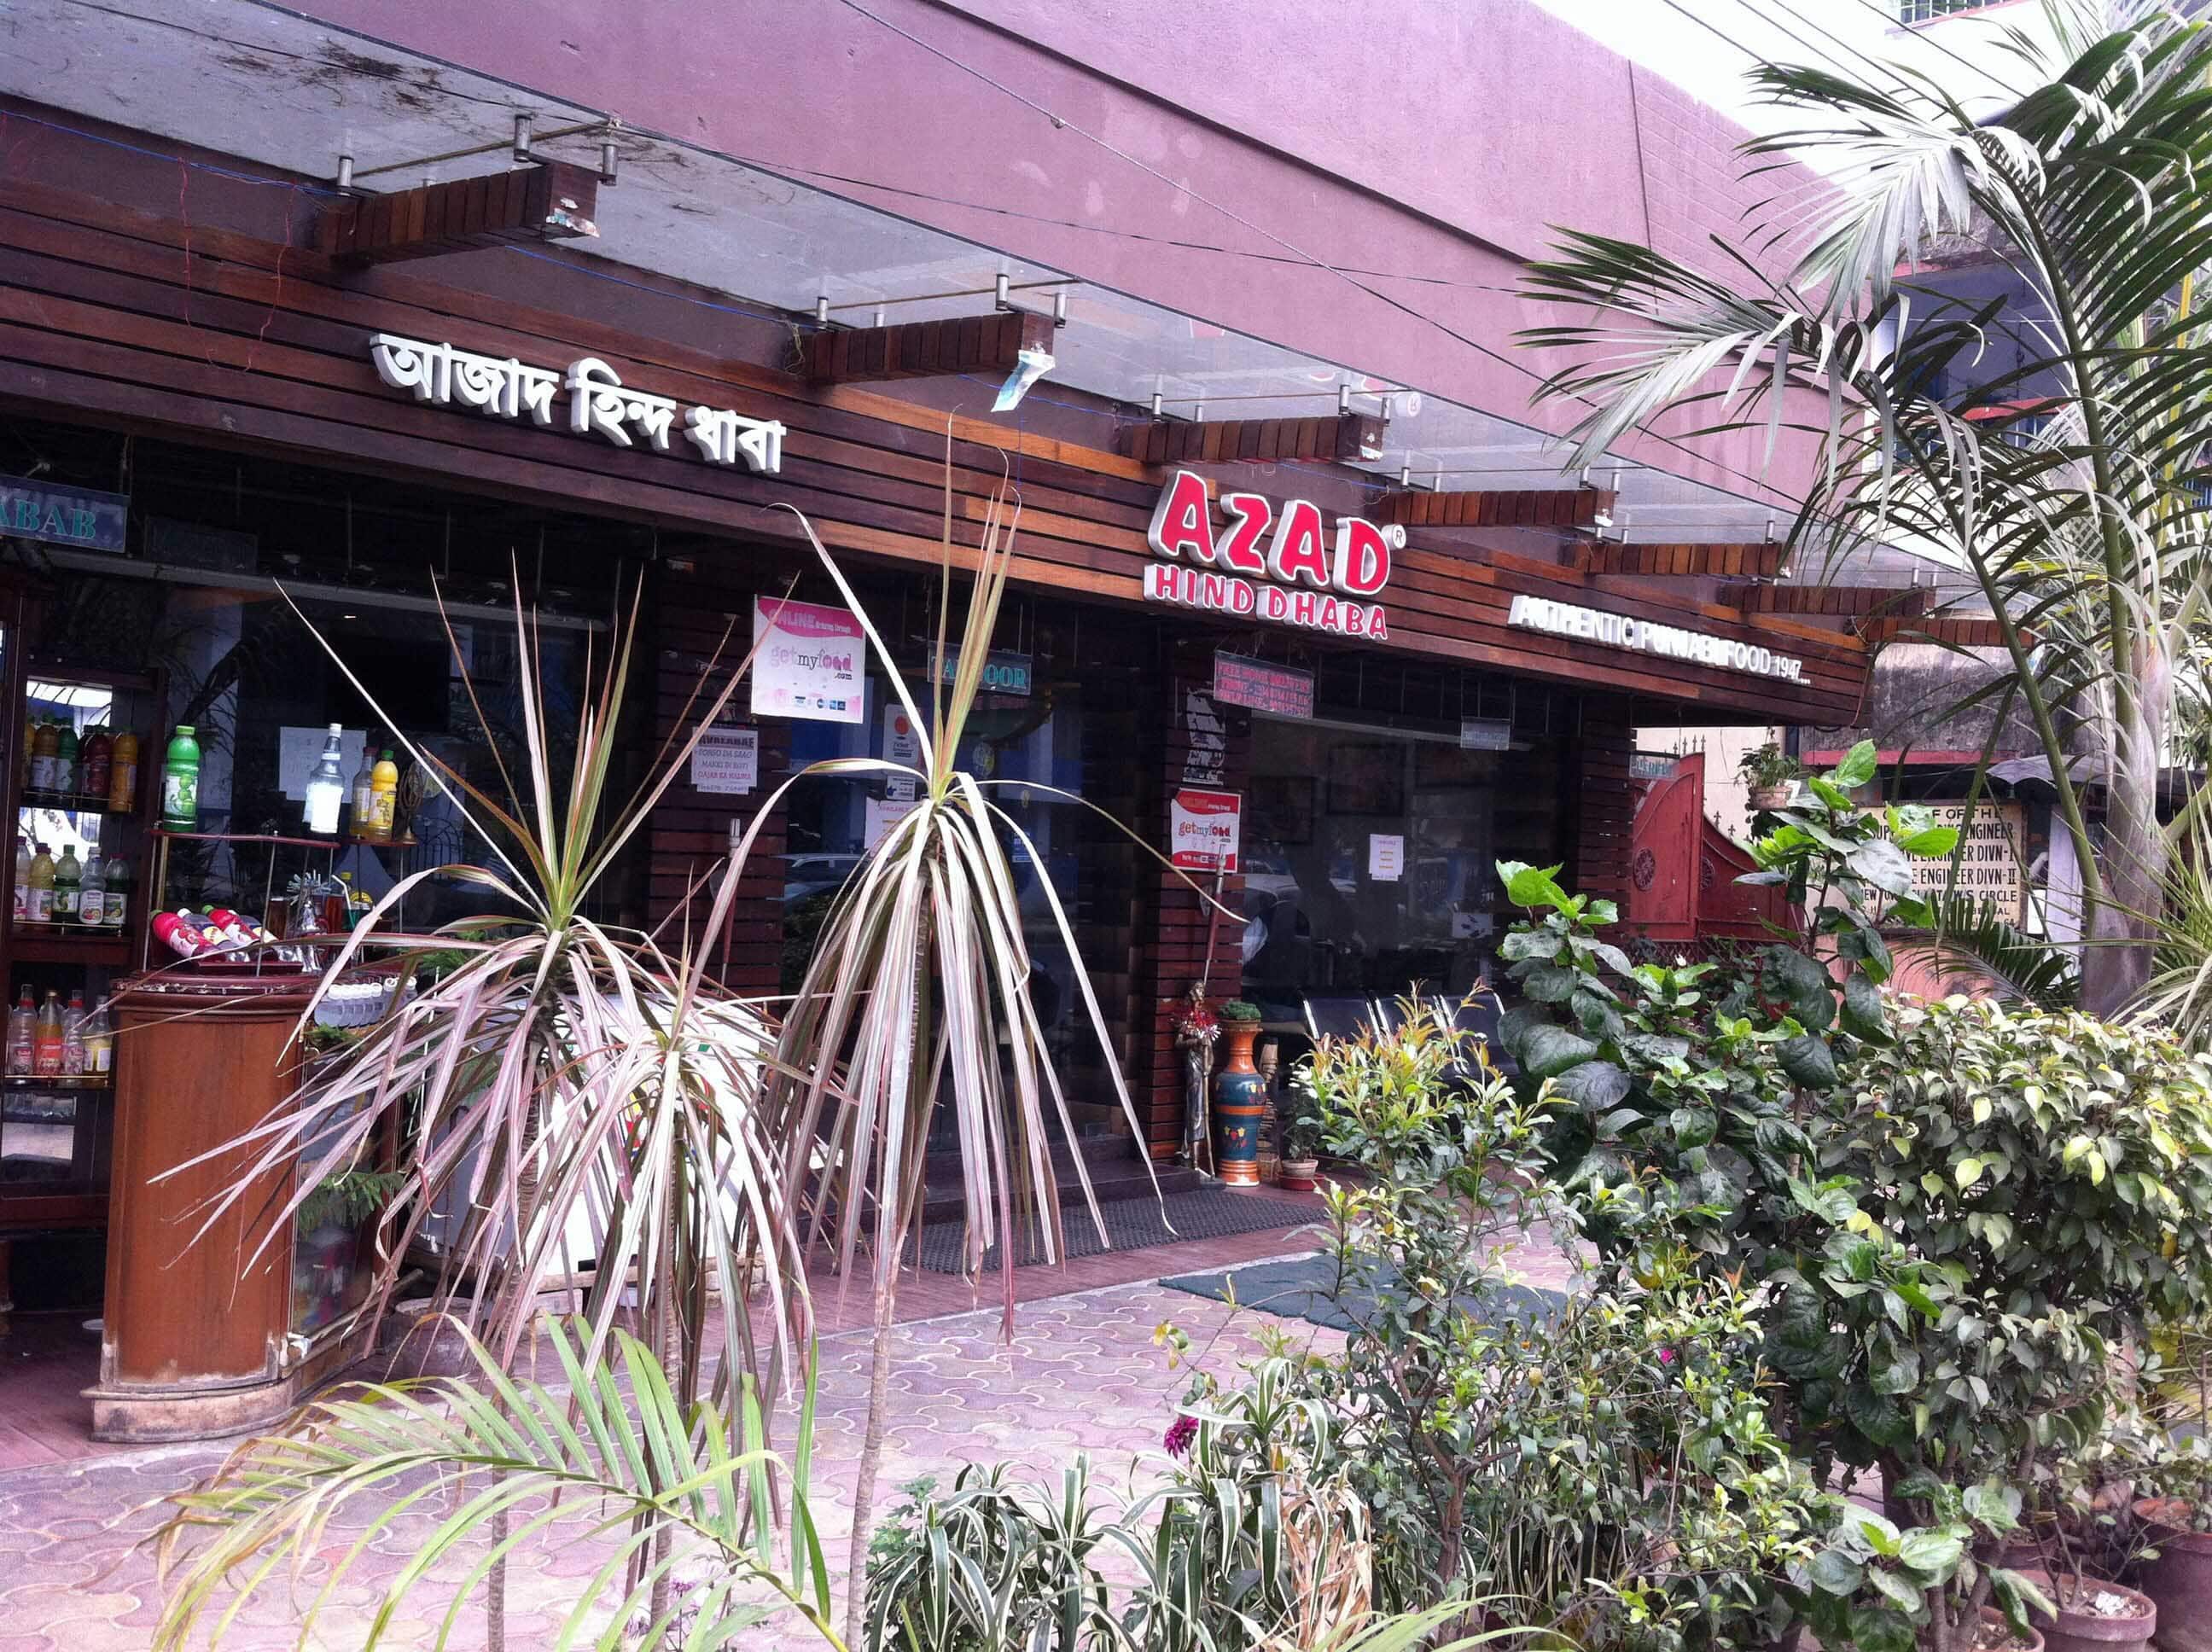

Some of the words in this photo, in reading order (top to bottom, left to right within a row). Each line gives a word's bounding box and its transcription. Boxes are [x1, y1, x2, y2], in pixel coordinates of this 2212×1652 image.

[370, 333, 559, 426] আজাদ
[565, 357, 677, 451] হিন্দ
[684, 405, 787, 474] ধাবা
[1148, 469, 1391, 596] AZAD
[1144, 563, 1254, 614] HIND
[1256, 585, 1388, 640] DHABA
[1508, 595, 1634, 646] AUTHENTIC
[1633, 620, 1719, 665] PUNJABI
[1717, 639, 1771, 674] FOOD
[1965, 823, 2014, 841] NGINEER
[1860, 887, 1877, 901] EW
[1979, 889, 2017, 902] CIRCLE
[1976, 868, 2017, 885] DIVN-II
